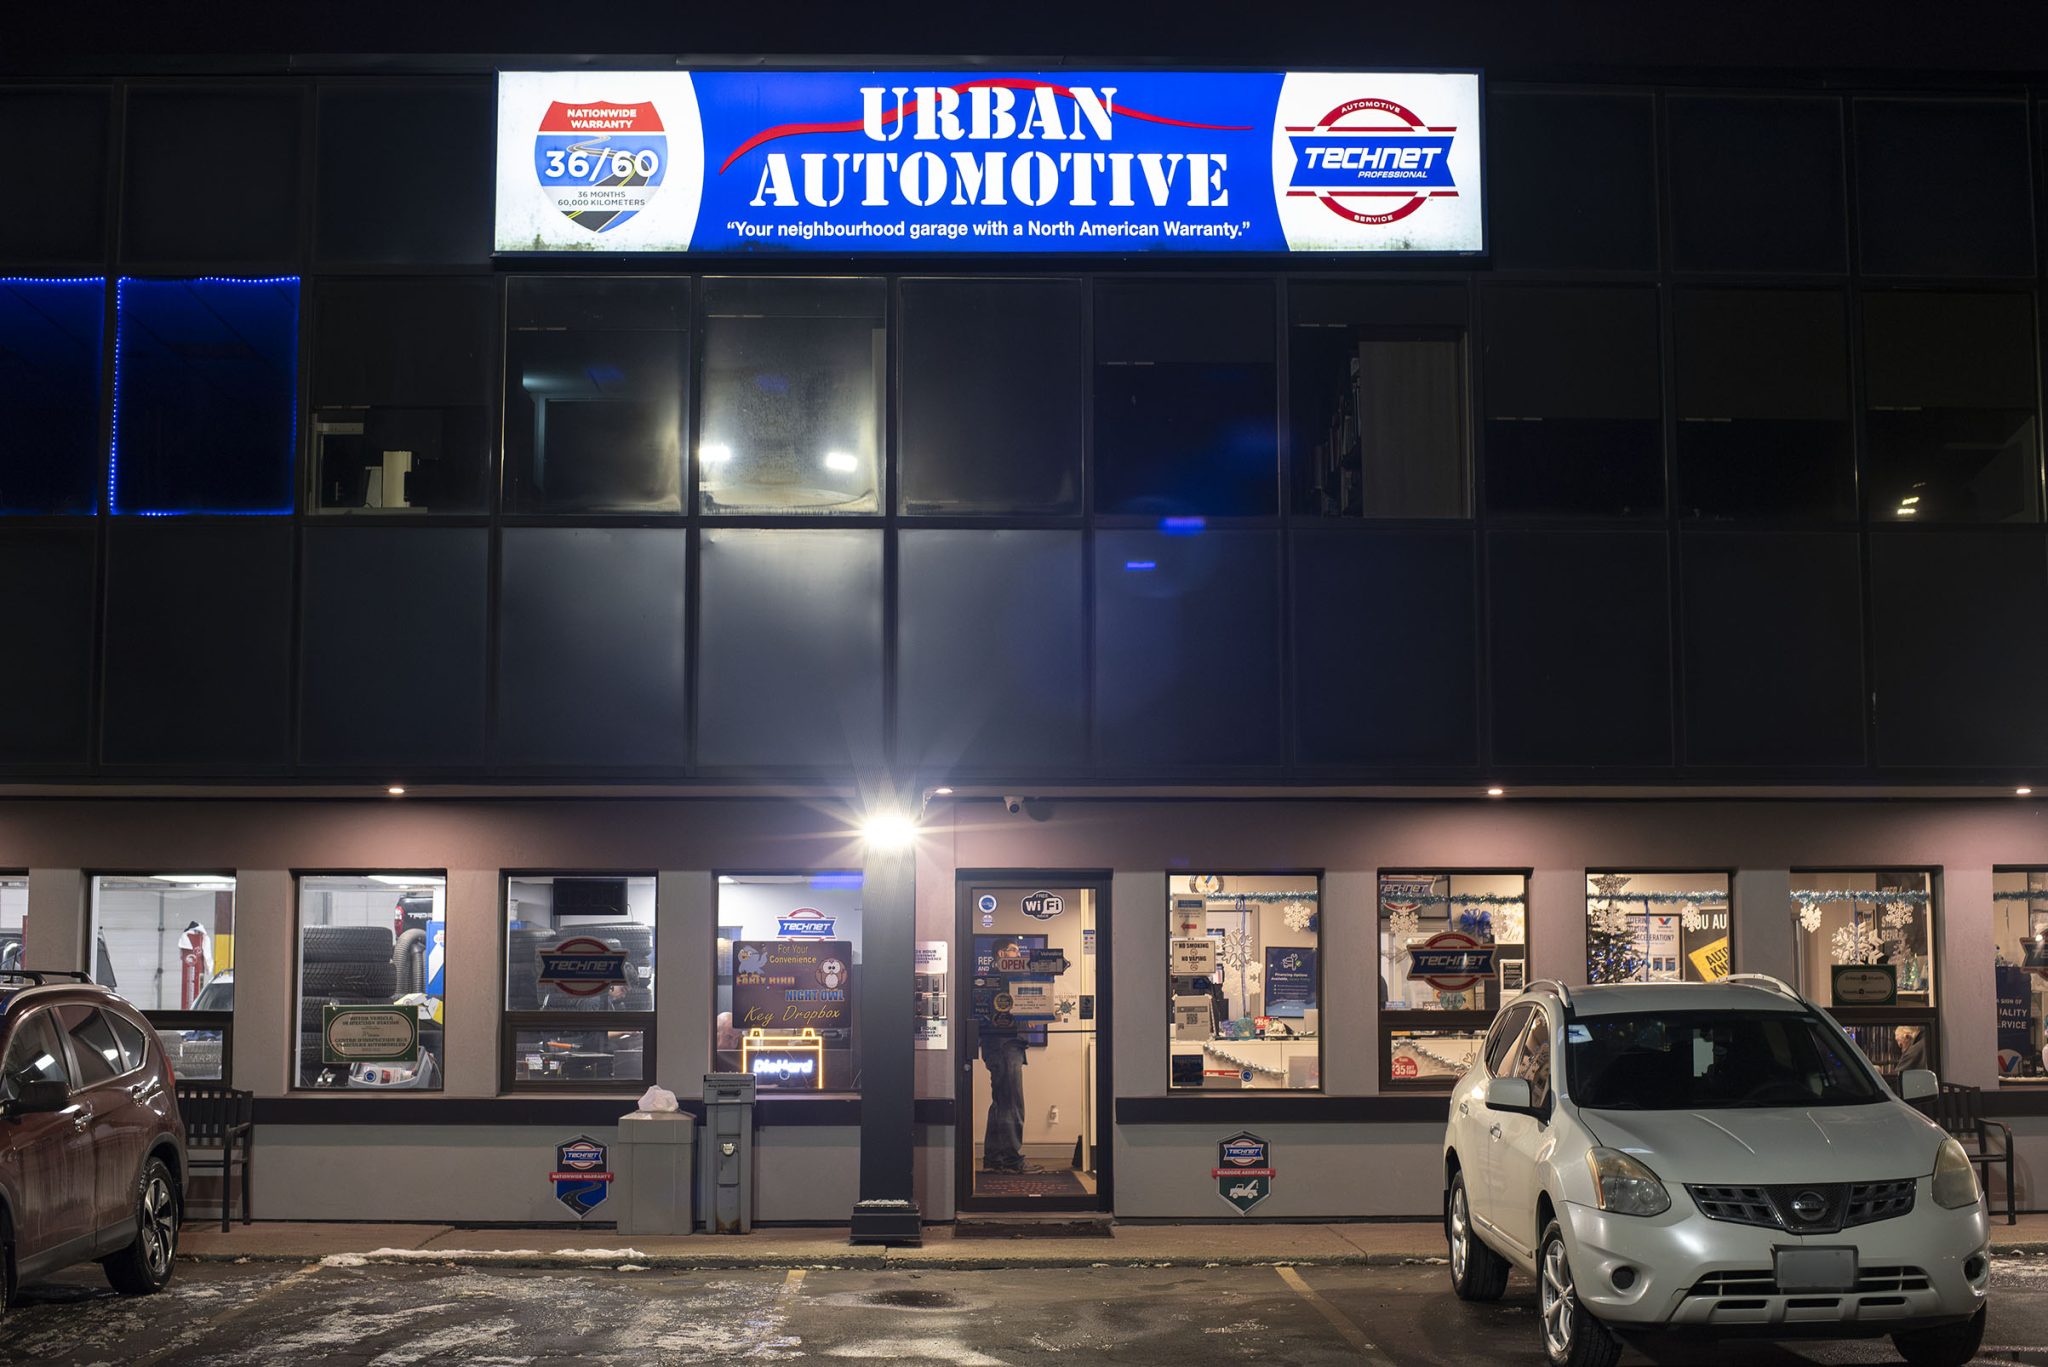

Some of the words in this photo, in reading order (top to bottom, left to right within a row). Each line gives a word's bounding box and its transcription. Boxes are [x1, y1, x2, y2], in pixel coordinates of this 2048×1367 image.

[1341, 101, 1401, 114] AUTOMOTIVE
[567, 108, 637, 118] NATIONWIDE
[859, 86, 1118, 142] URBAN
[571, 120, 633, 129] WARRANTY
[545, 147, 659, 182] 36/60
[749, 151, 1229, 208] AUTOMOTIVE
[1357, 171, 1428, 179] PROFESSIONAL
[558, 199, 589, 207] 60,000
[1354, 214, 1394, 223] SERVICE
[778, 221, 905, 240] neighbourhood
[910, 224, 968, 240] garage
[973, 221, 1008, 236] with
[1013, 225, 1023, 236] a
[1028, 221, 1075, 236] North
[1079, 221, 1159, 236] American
[778, 944, 791, 954] For
[792, 945, 809, 954] Your
[769, 955, 817, 964] Convenience
[1001, 960, 1025, 969] OPEN
[785, 989, 818, 1001] NIGHT
[820, 989, 845, 1002] OWL
[744, 1006, 774, 1026] Key
[783, 1004, 841, 1025] Dropbox
[1999, 1009, 2028, 1017] ALITY
[1997, 1021, 2028, 1029] RVICE
